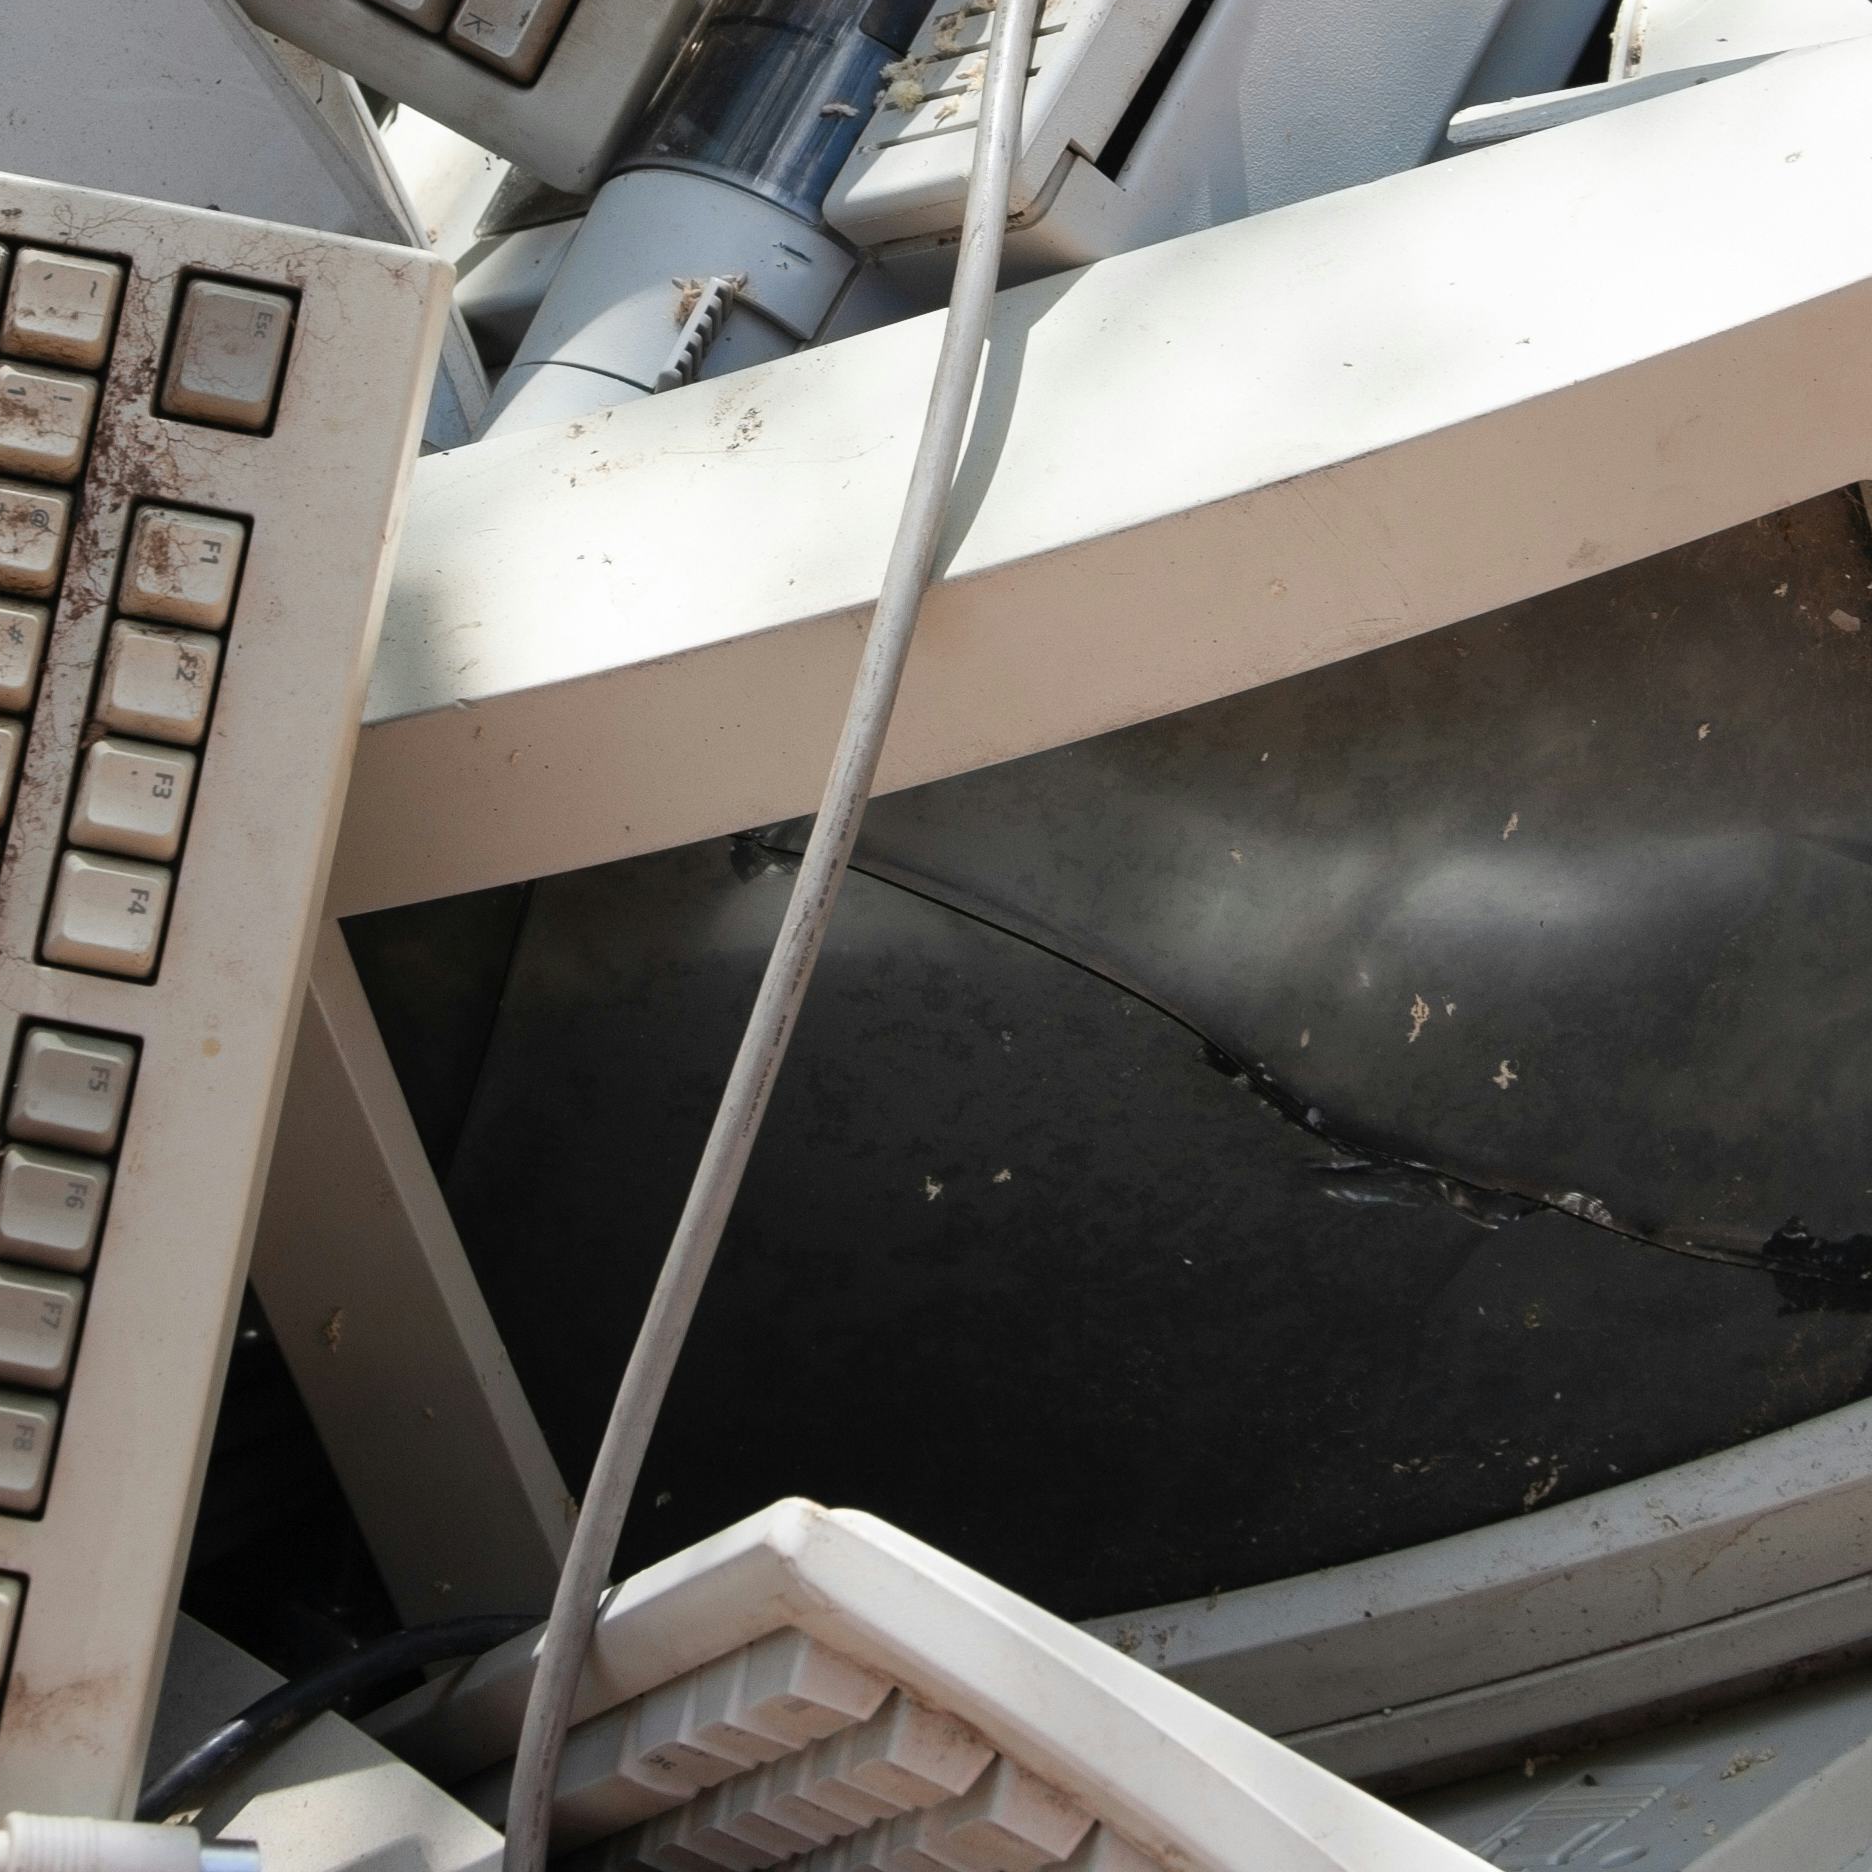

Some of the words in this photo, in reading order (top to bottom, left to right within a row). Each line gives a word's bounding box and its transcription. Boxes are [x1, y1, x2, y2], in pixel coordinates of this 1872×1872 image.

[254, 311, 272, 339] Esc
[202, 538, 223, 567] F1
[176, 655, 197, 683] F2
[150, 770, 173, 801] F3
[128, 885, 150, 915] F4
[88, 1064, 109, 1095] F5
[65, 1181, 88, 1212] F6
[41, 1300, 61, 1331] F7
[14, 1423, 34, 1453] F8
